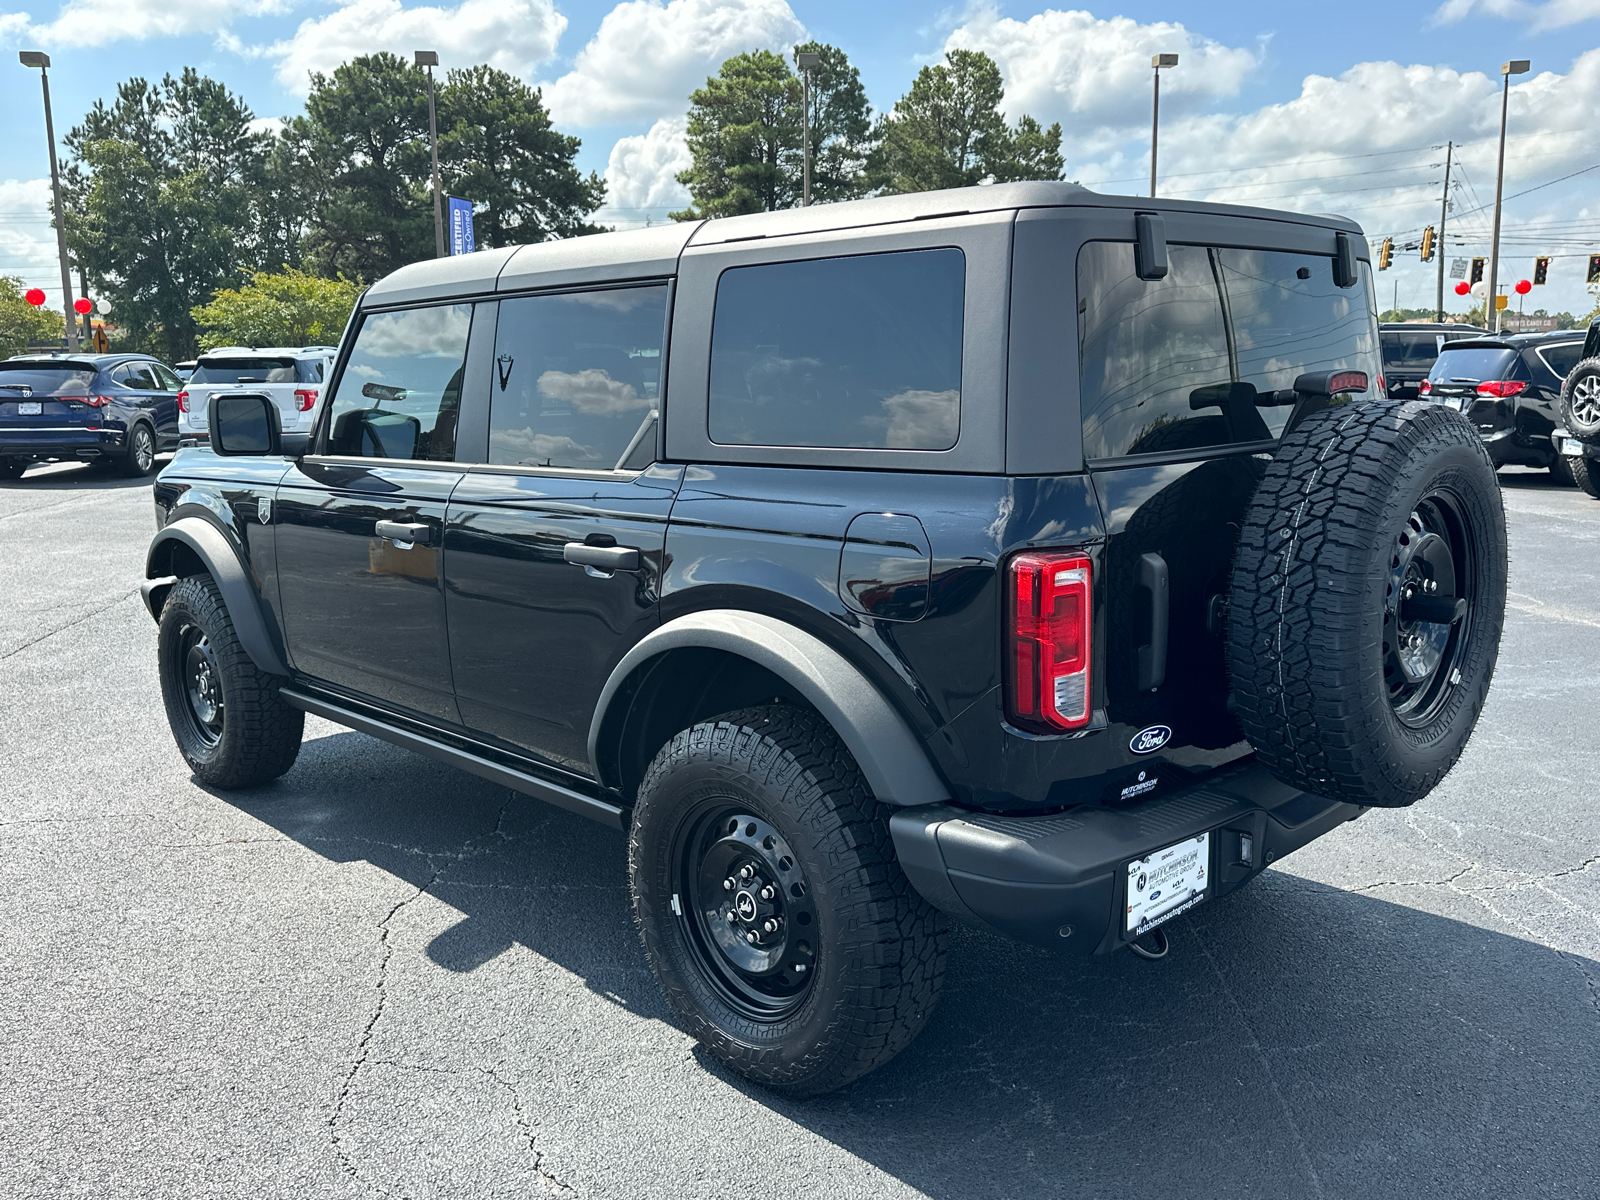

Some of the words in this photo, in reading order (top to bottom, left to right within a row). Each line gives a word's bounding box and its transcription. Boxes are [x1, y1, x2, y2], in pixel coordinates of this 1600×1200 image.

[463, 209, 473, 254] re-Owned
[1526, 319, 1543, 327] CANDY
[1138, 729, 1165, 750] Ford
[1121, 778, 1158, 795] HUTCHINSON
[1161, 850, 1175, 861] GMC
[1148, 849, 1198, 884] HUTCHINSON
[1148, 868, 1180, 891] AUTOMOTIVE
[1180, 861, 1196, 876] GROUP
